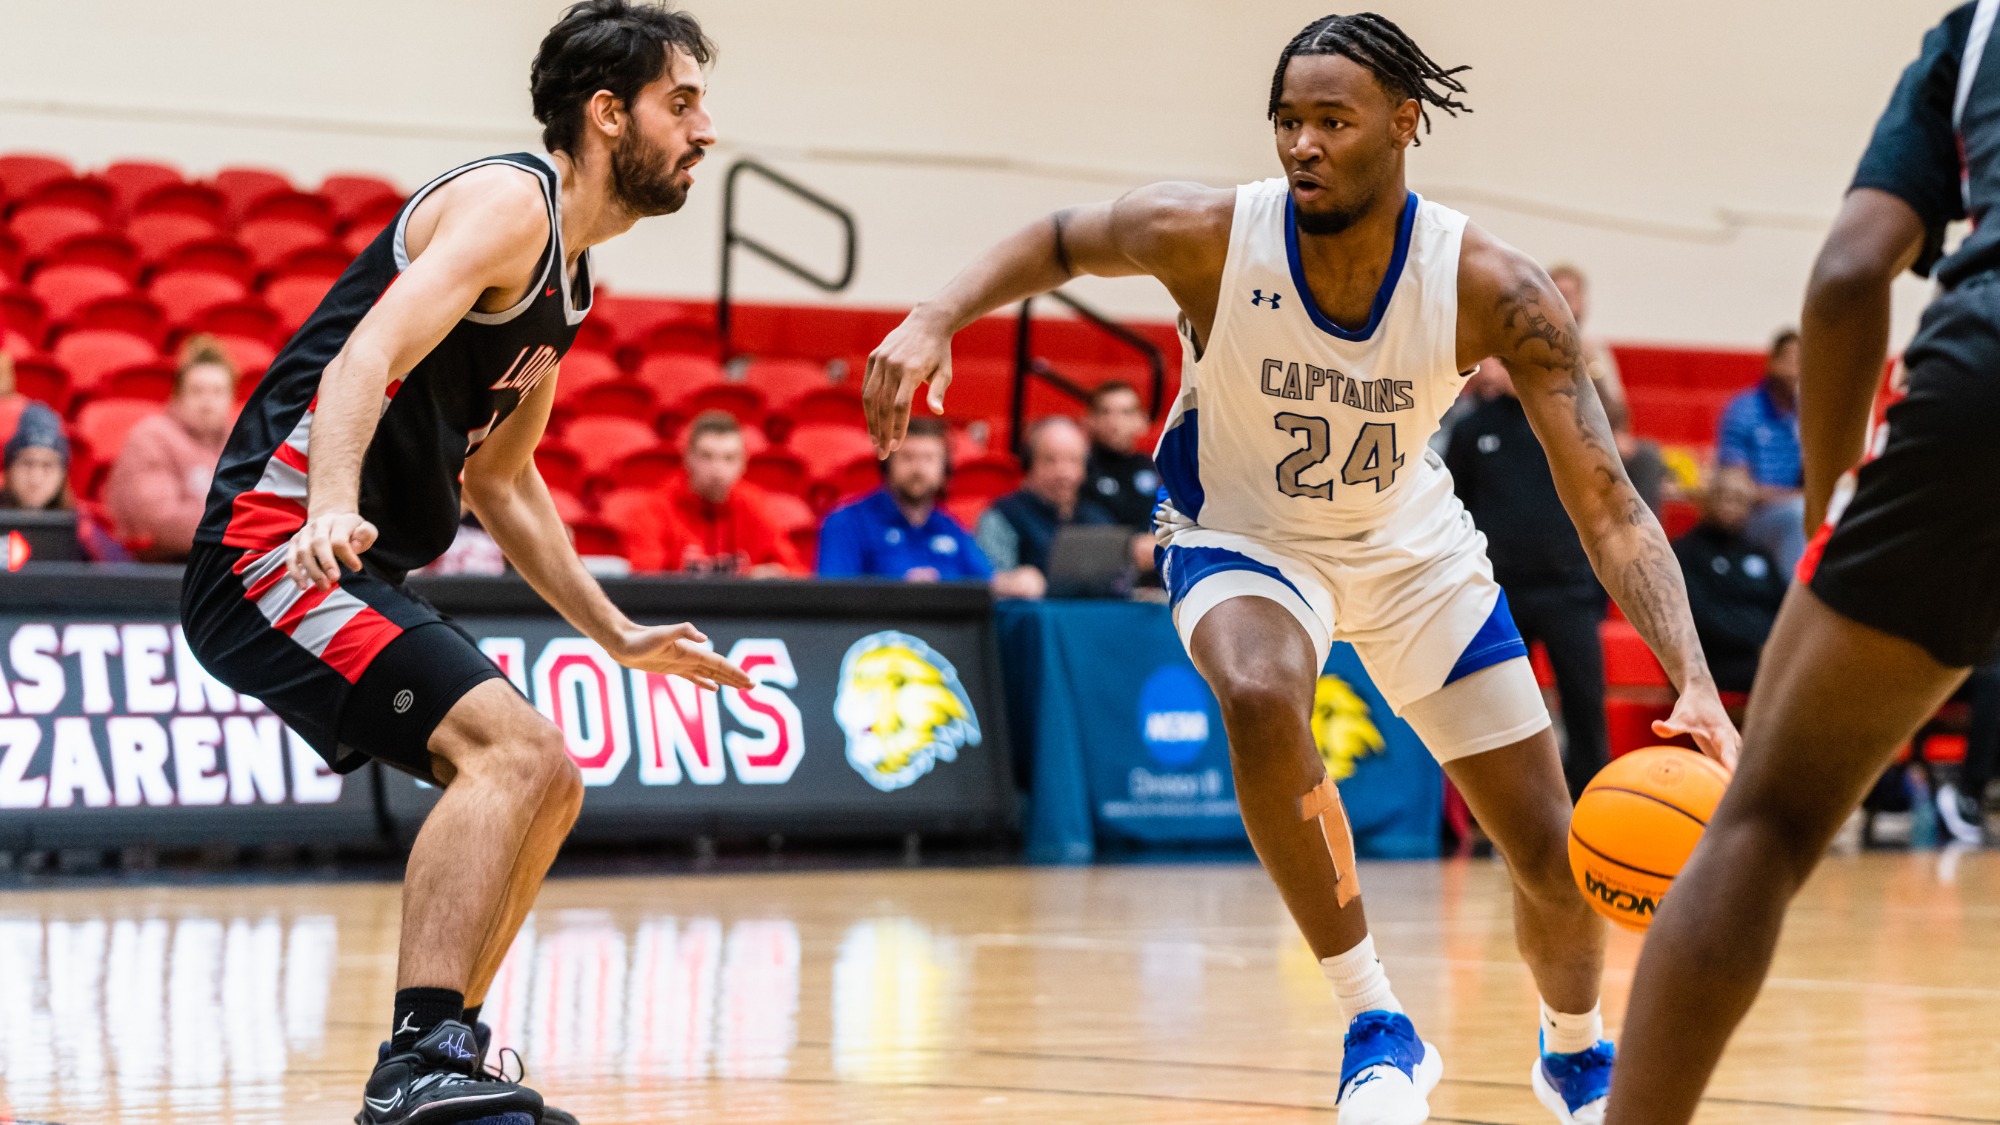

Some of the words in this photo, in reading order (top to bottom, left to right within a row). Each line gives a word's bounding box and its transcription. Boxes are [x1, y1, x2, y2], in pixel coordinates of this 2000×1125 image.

[1261, 359, 1414, 412] CAPTAINS
[1273, 411, 1405, 501] 24
[1585, 870, 1663, 917] NCAA
